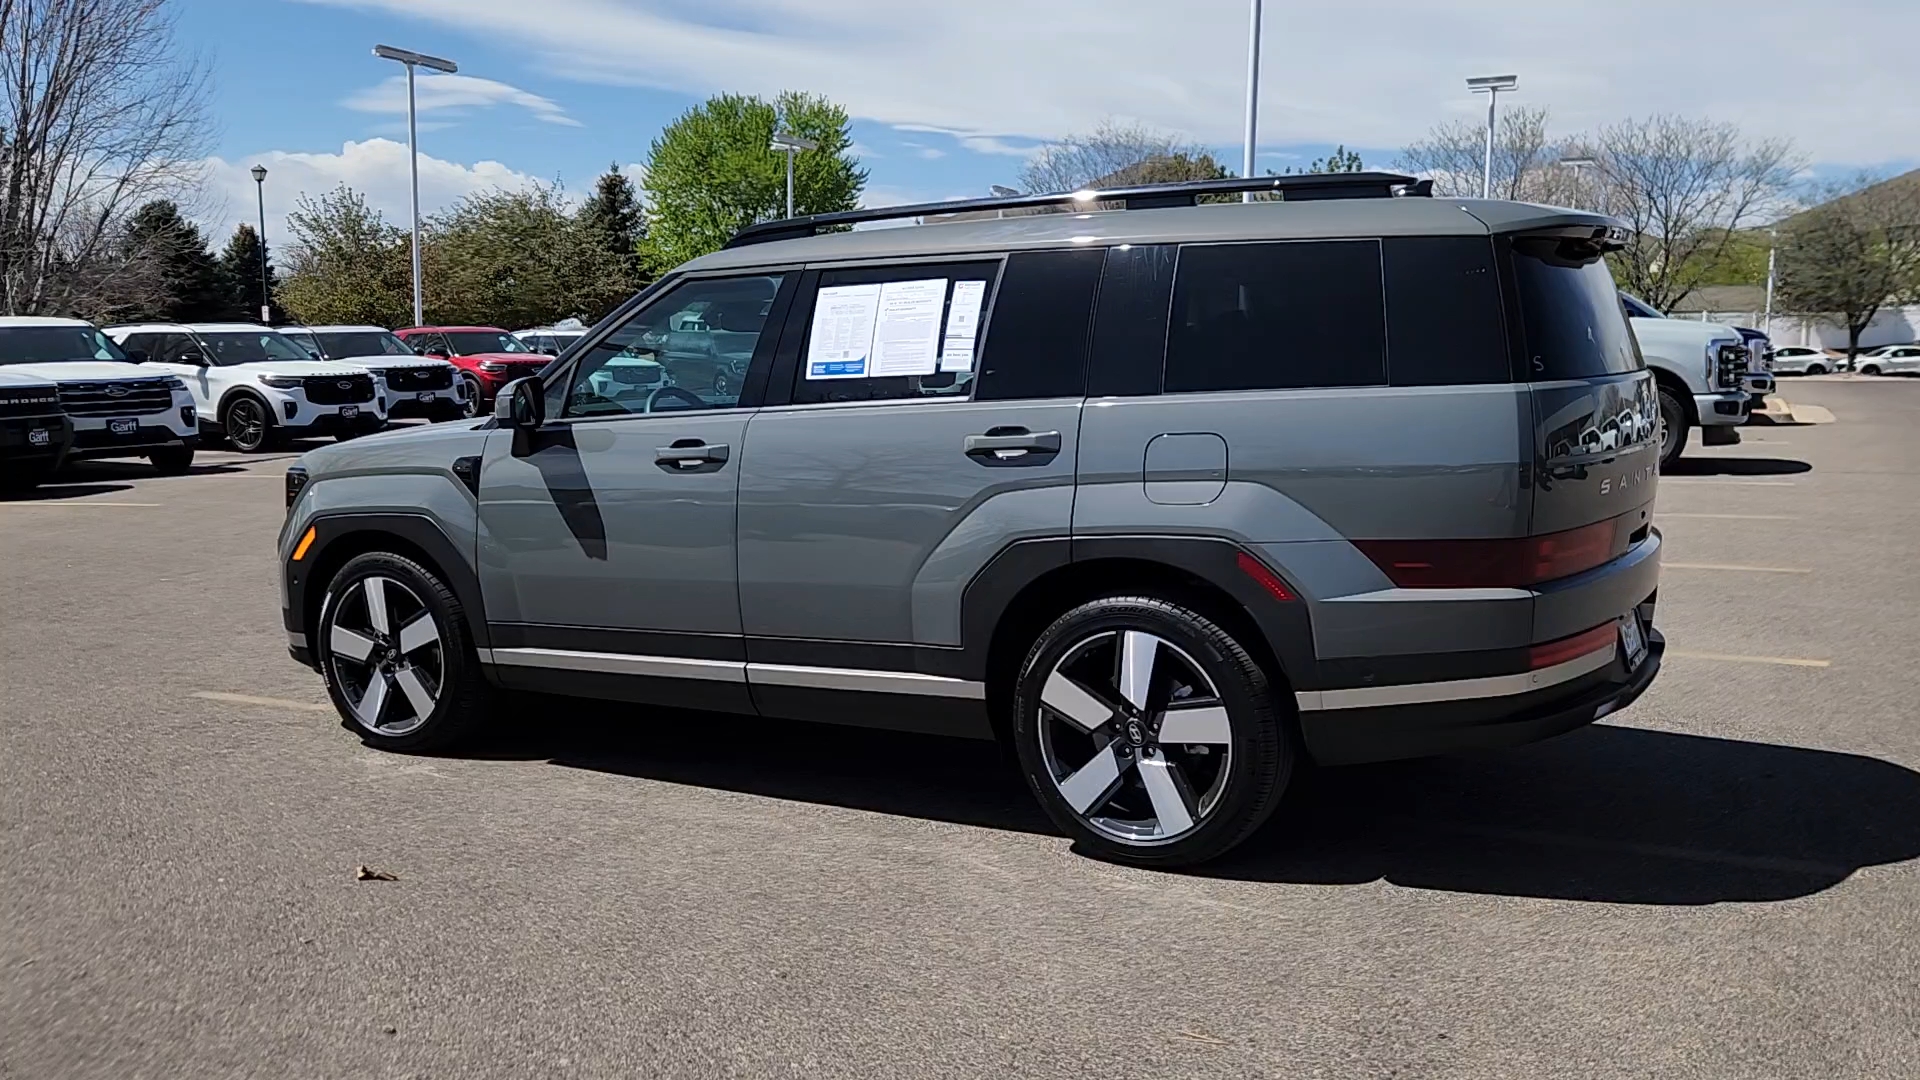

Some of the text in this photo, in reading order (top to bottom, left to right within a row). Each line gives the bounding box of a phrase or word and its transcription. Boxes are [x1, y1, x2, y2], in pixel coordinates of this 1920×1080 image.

[1533, 355, 1544, 371] S
[111, 421, 137, 432] Garff
[29, 431, 49, 443] Garff
